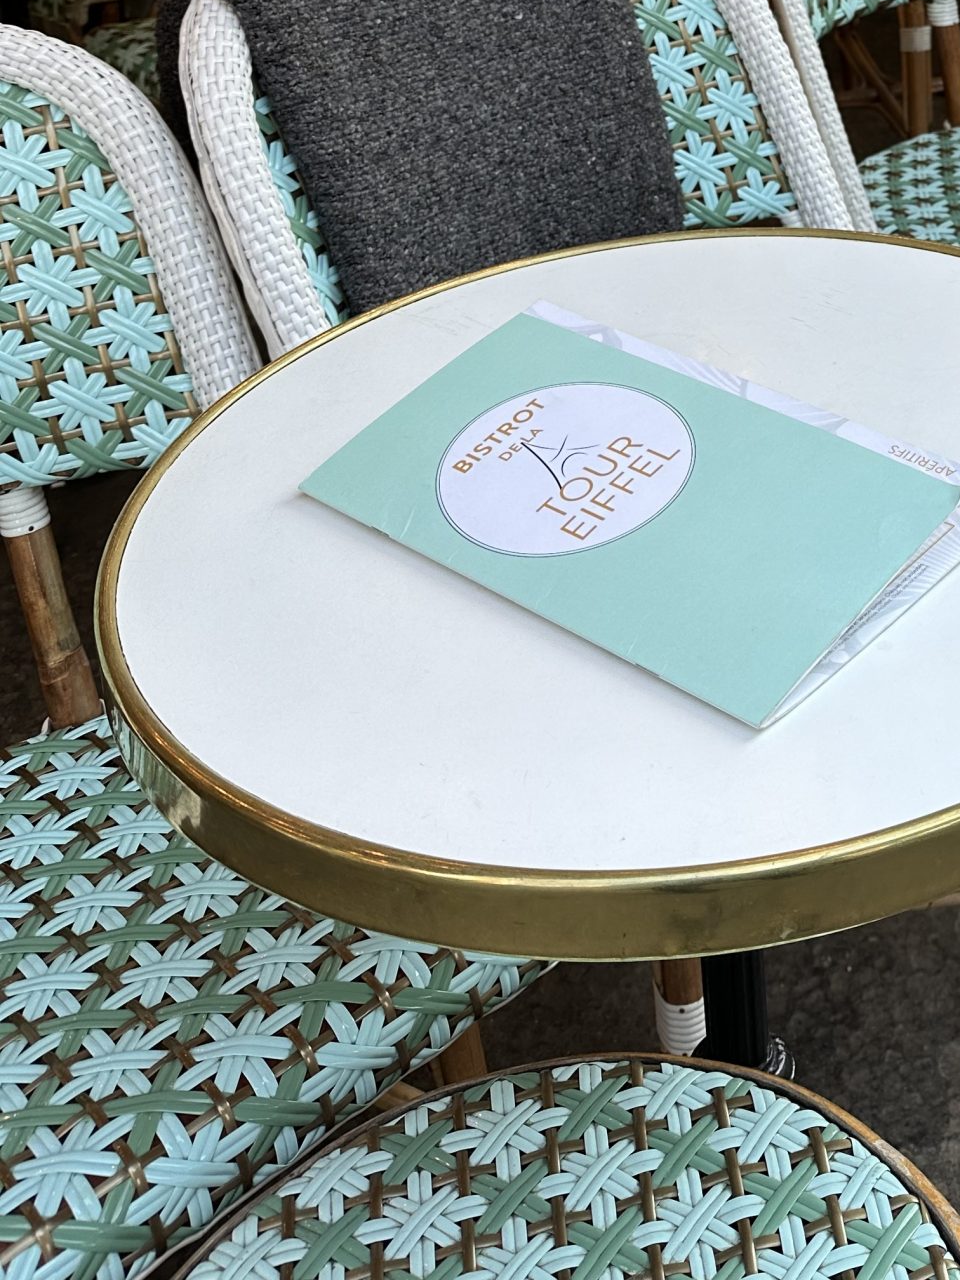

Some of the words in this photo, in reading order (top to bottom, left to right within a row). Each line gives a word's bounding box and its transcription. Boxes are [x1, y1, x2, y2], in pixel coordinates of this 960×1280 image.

[452, 398, 545, 474] BISTROT
[498, 443, 522, 461] DE
[520, 426, 544, 443] LA
[888, 444, 957, 477] APÉRITIFS
[536, 436, 644, 516] TOUR
[560, 449, 681, 541] EIFFEL
